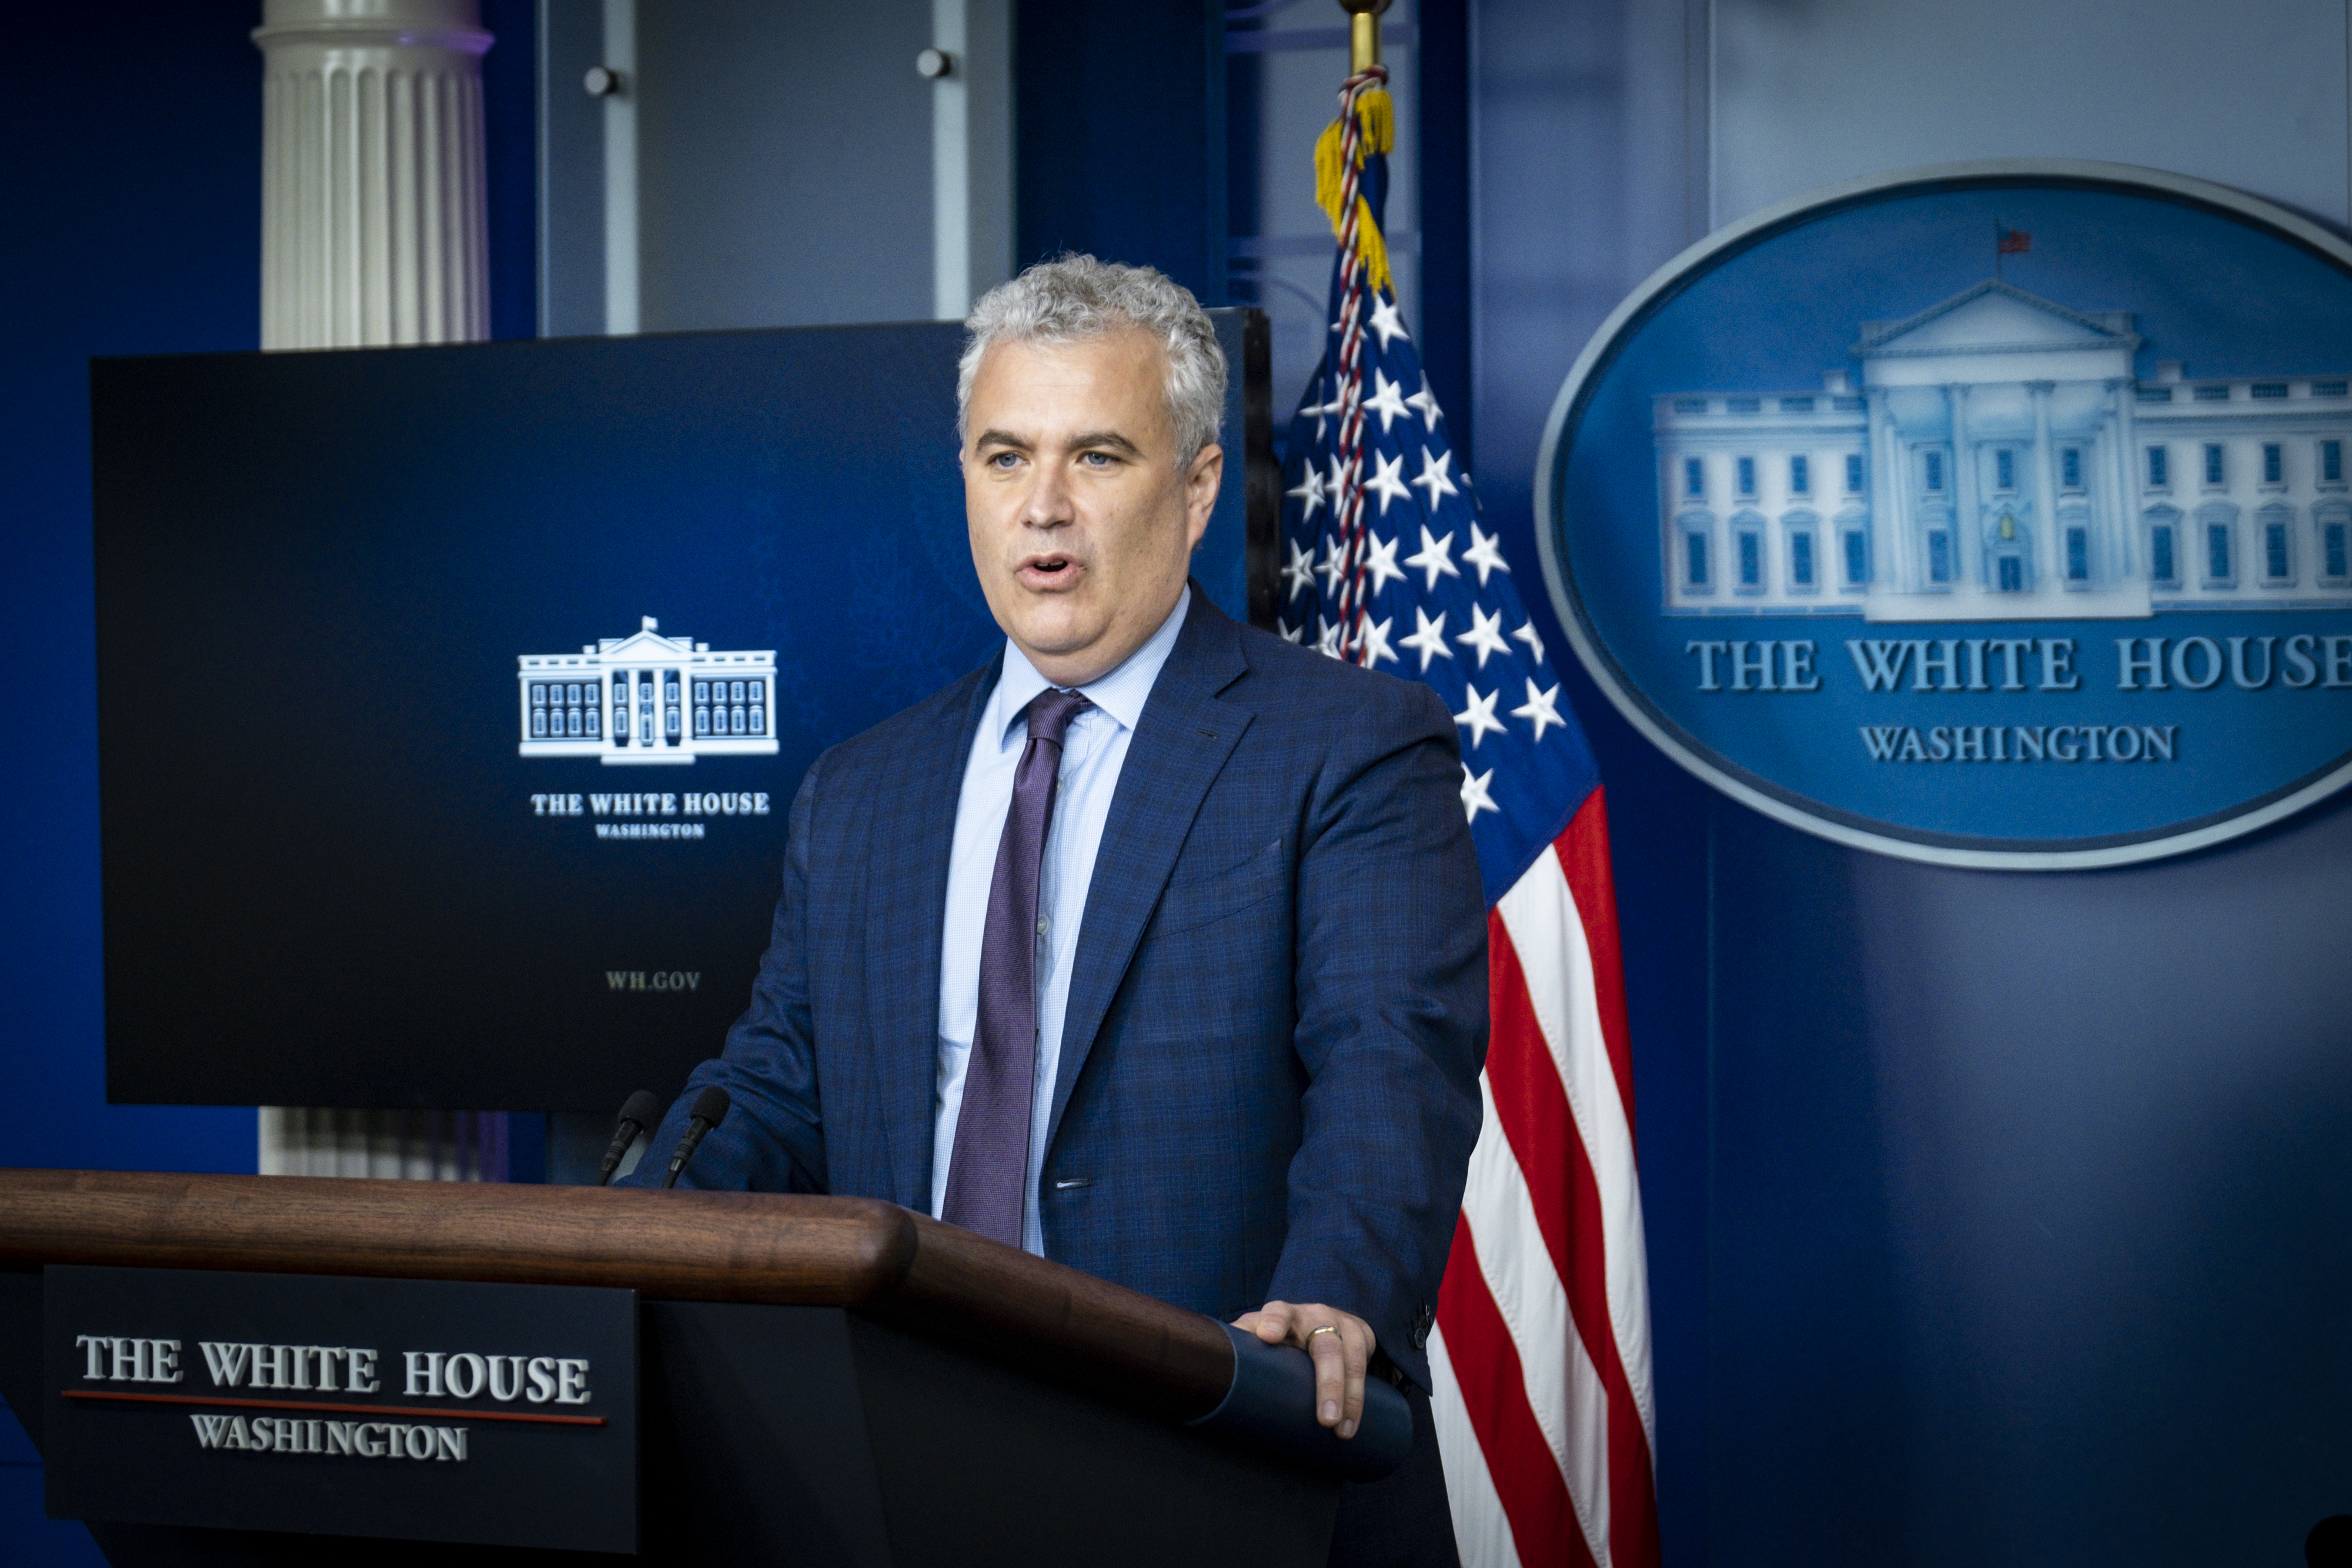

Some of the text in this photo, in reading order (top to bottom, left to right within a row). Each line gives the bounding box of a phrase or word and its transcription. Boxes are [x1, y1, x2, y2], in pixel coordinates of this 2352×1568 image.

[1686, 634, 2352, 691] THE WHITE HOUSE
[1858, 725, 2179, 763] WASHINGTON
[531, 791, 770, 816] THE WHITE HOUSE
[595, 823, 705, 840] WASHINGTON
[605, 971, 701, 991] WH.GOV
[76, 1335, 592, 1405] THE WHITE HOUSE
[189, 1414, 469, 1462] WASHINGTON
